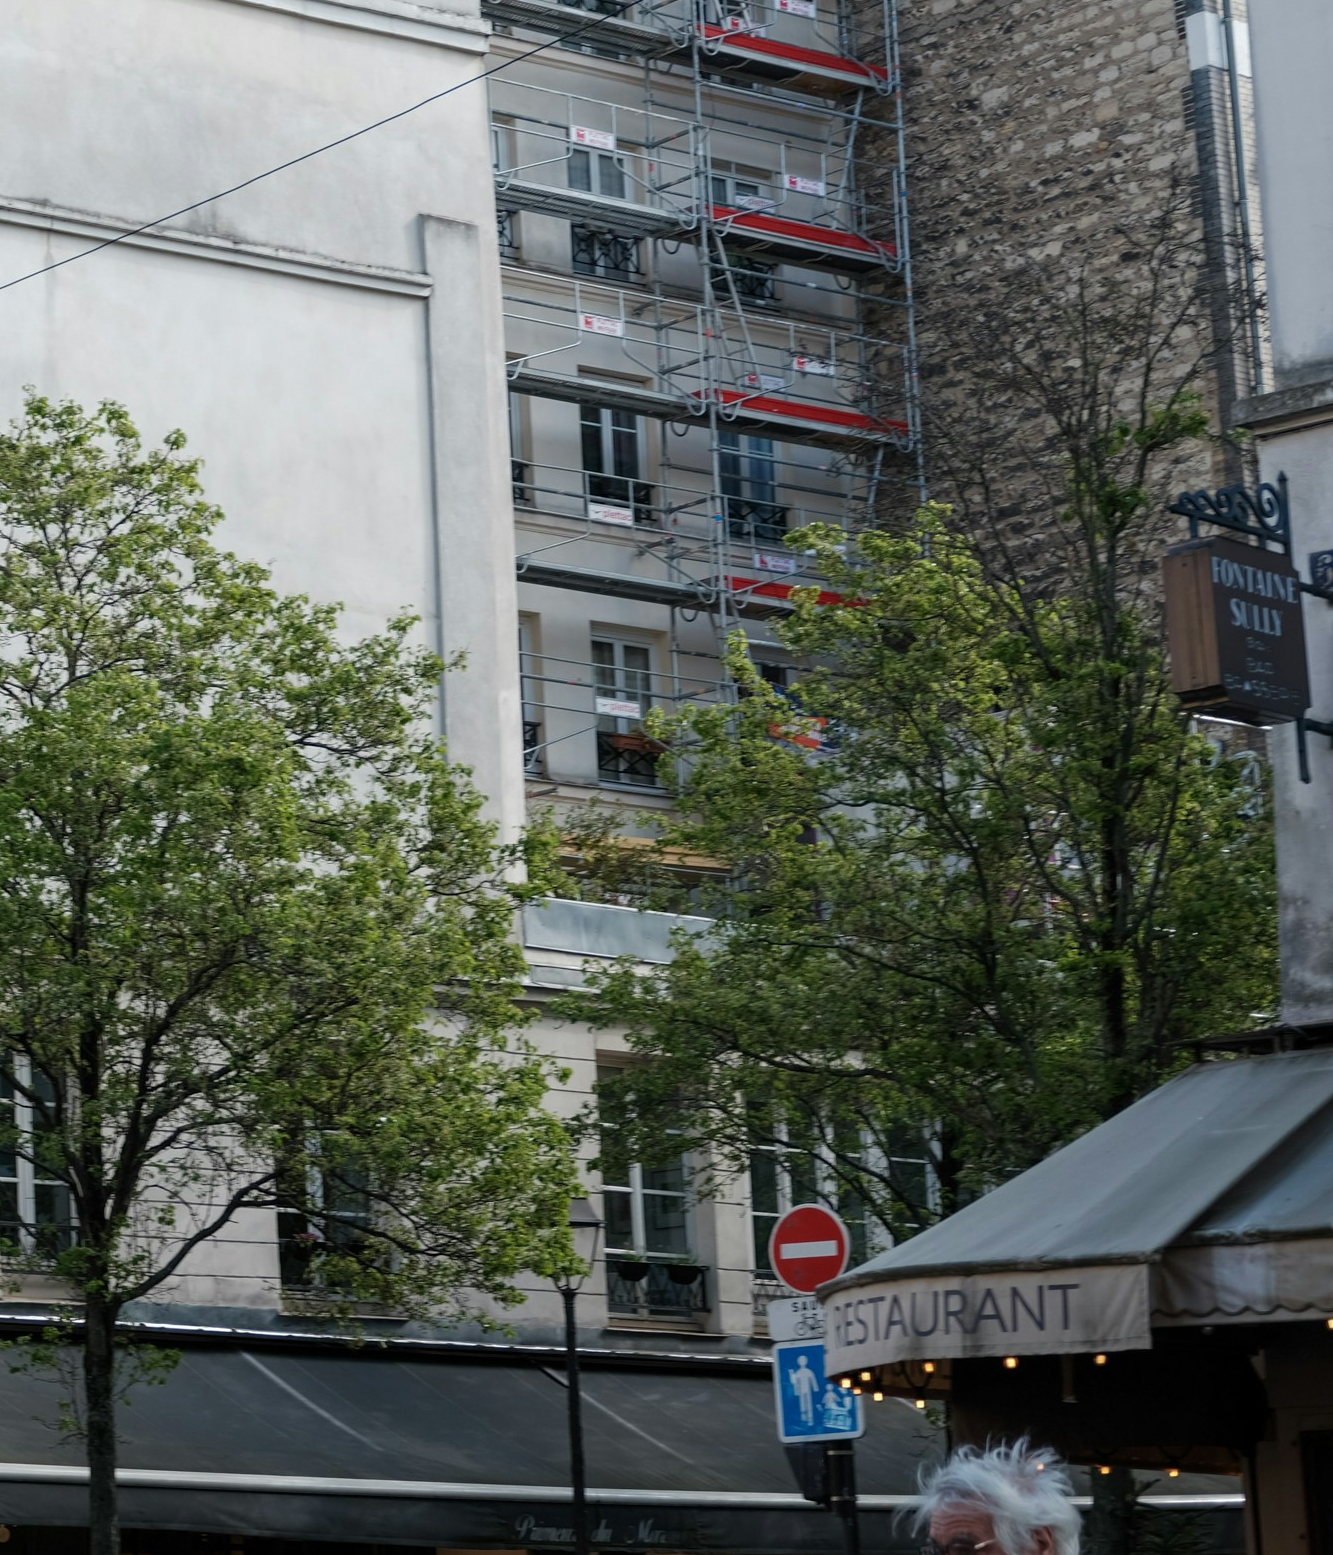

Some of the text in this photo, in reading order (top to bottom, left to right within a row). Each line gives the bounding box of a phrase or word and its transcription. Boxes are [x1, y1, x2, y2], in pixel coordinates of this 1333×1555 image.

[1210, 555, 1299, 604] FONTAINE
[1229, 597, 1283, 637] SULLY
[791, 1301, 824, 1313] SAU
[834, 1282, 1081, 1349] RESTAURANT
